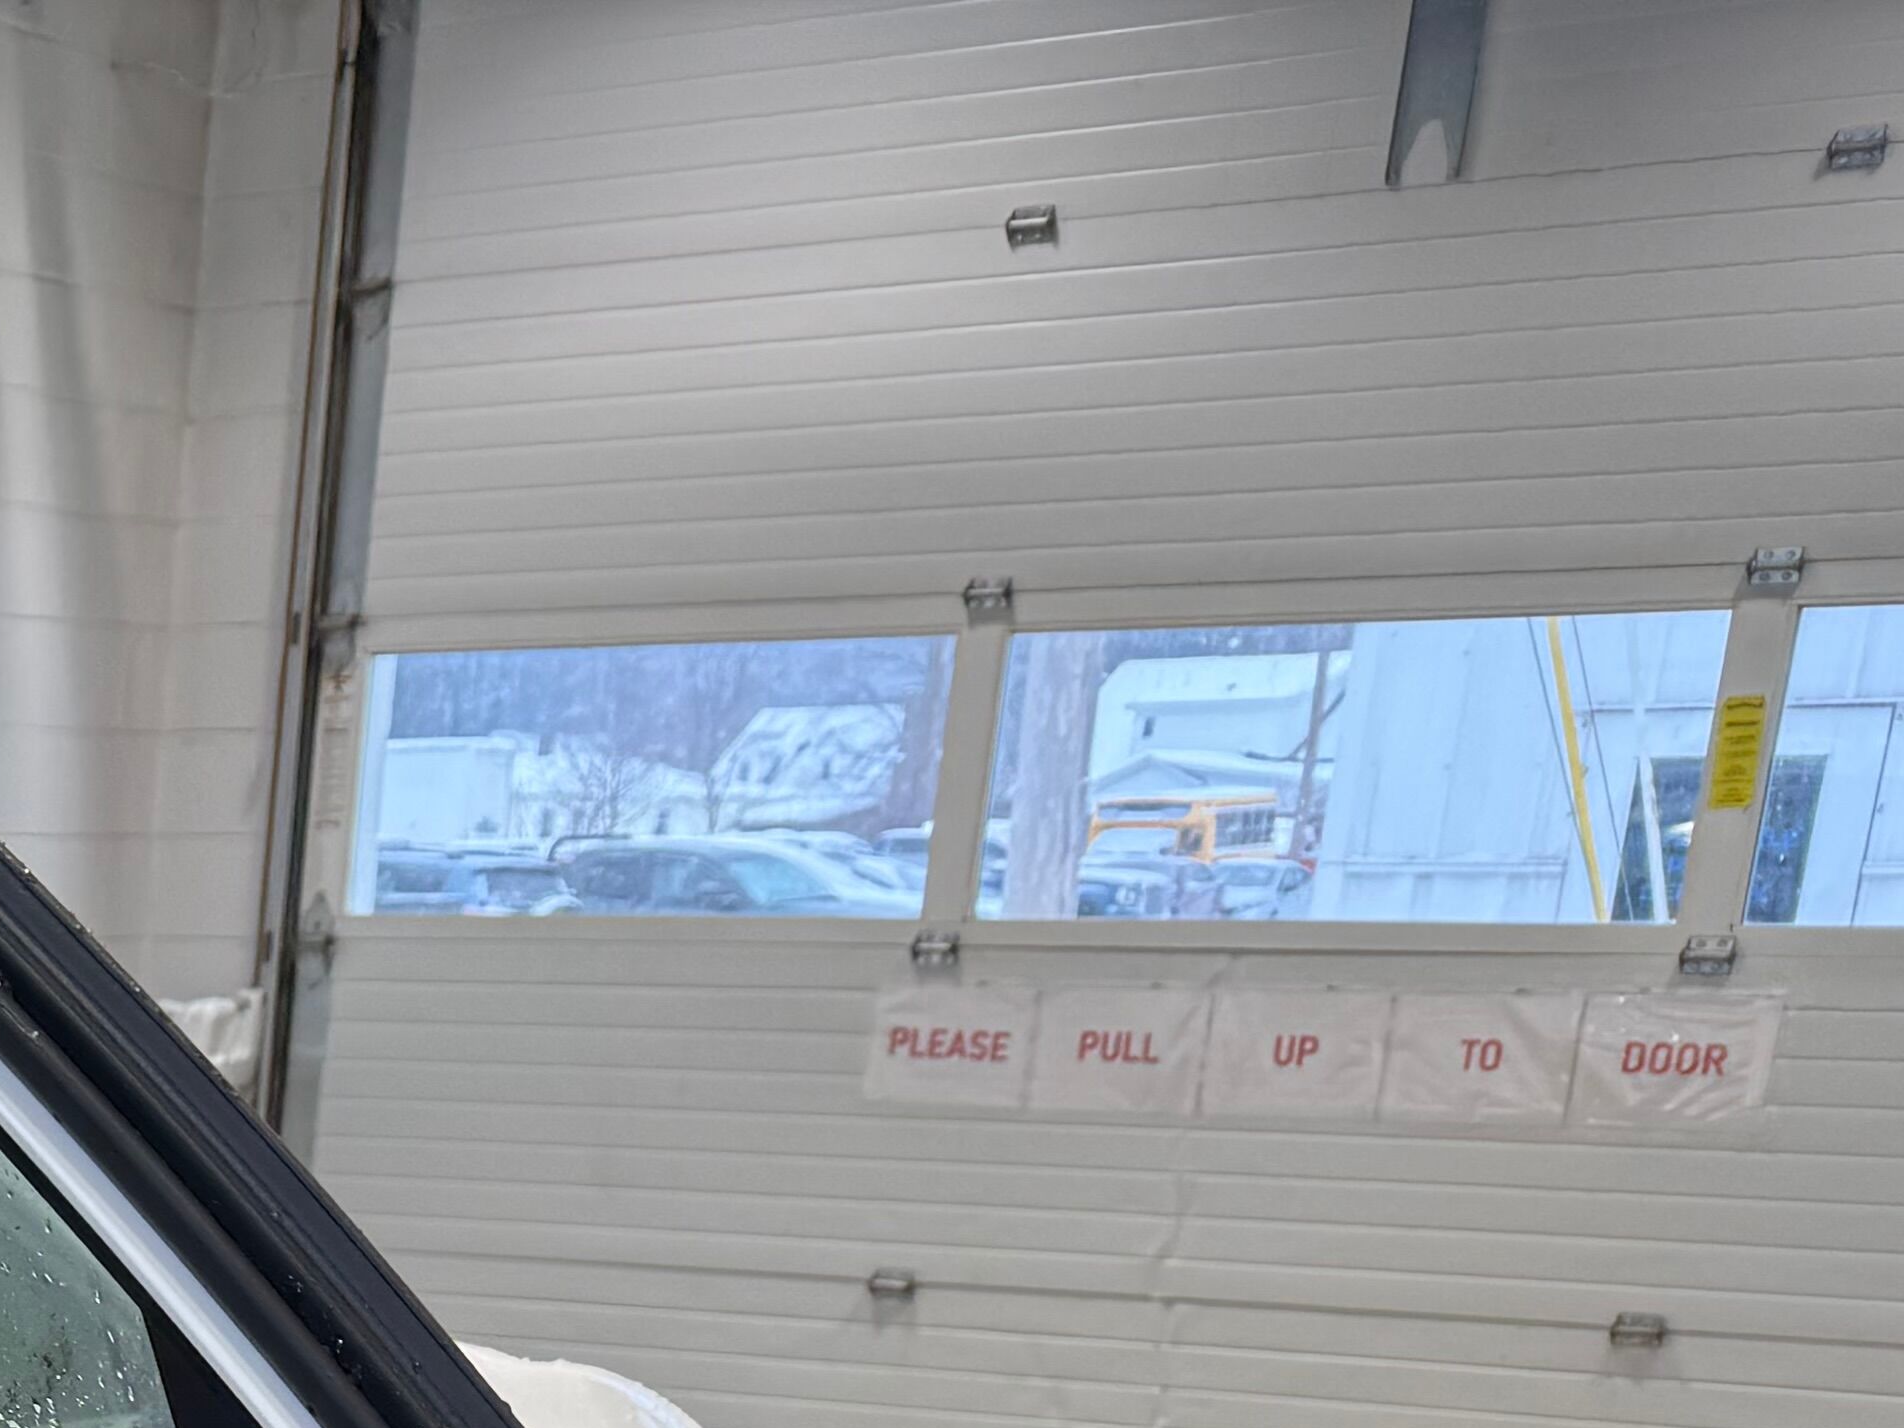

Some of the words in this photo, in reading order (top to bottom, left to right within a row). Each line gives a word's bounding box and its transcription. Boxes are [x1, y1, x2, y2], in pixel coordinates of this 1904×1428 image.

[886, 1025, 1012, 1064] PLEASE
[1077, 1030, 1160, 1066] PULL
[1271, 1034, 1320, 1069] UP
[1459, 1038, 1504, 1074] TO
[1620, 1042, 1728, 1078] DOOR
